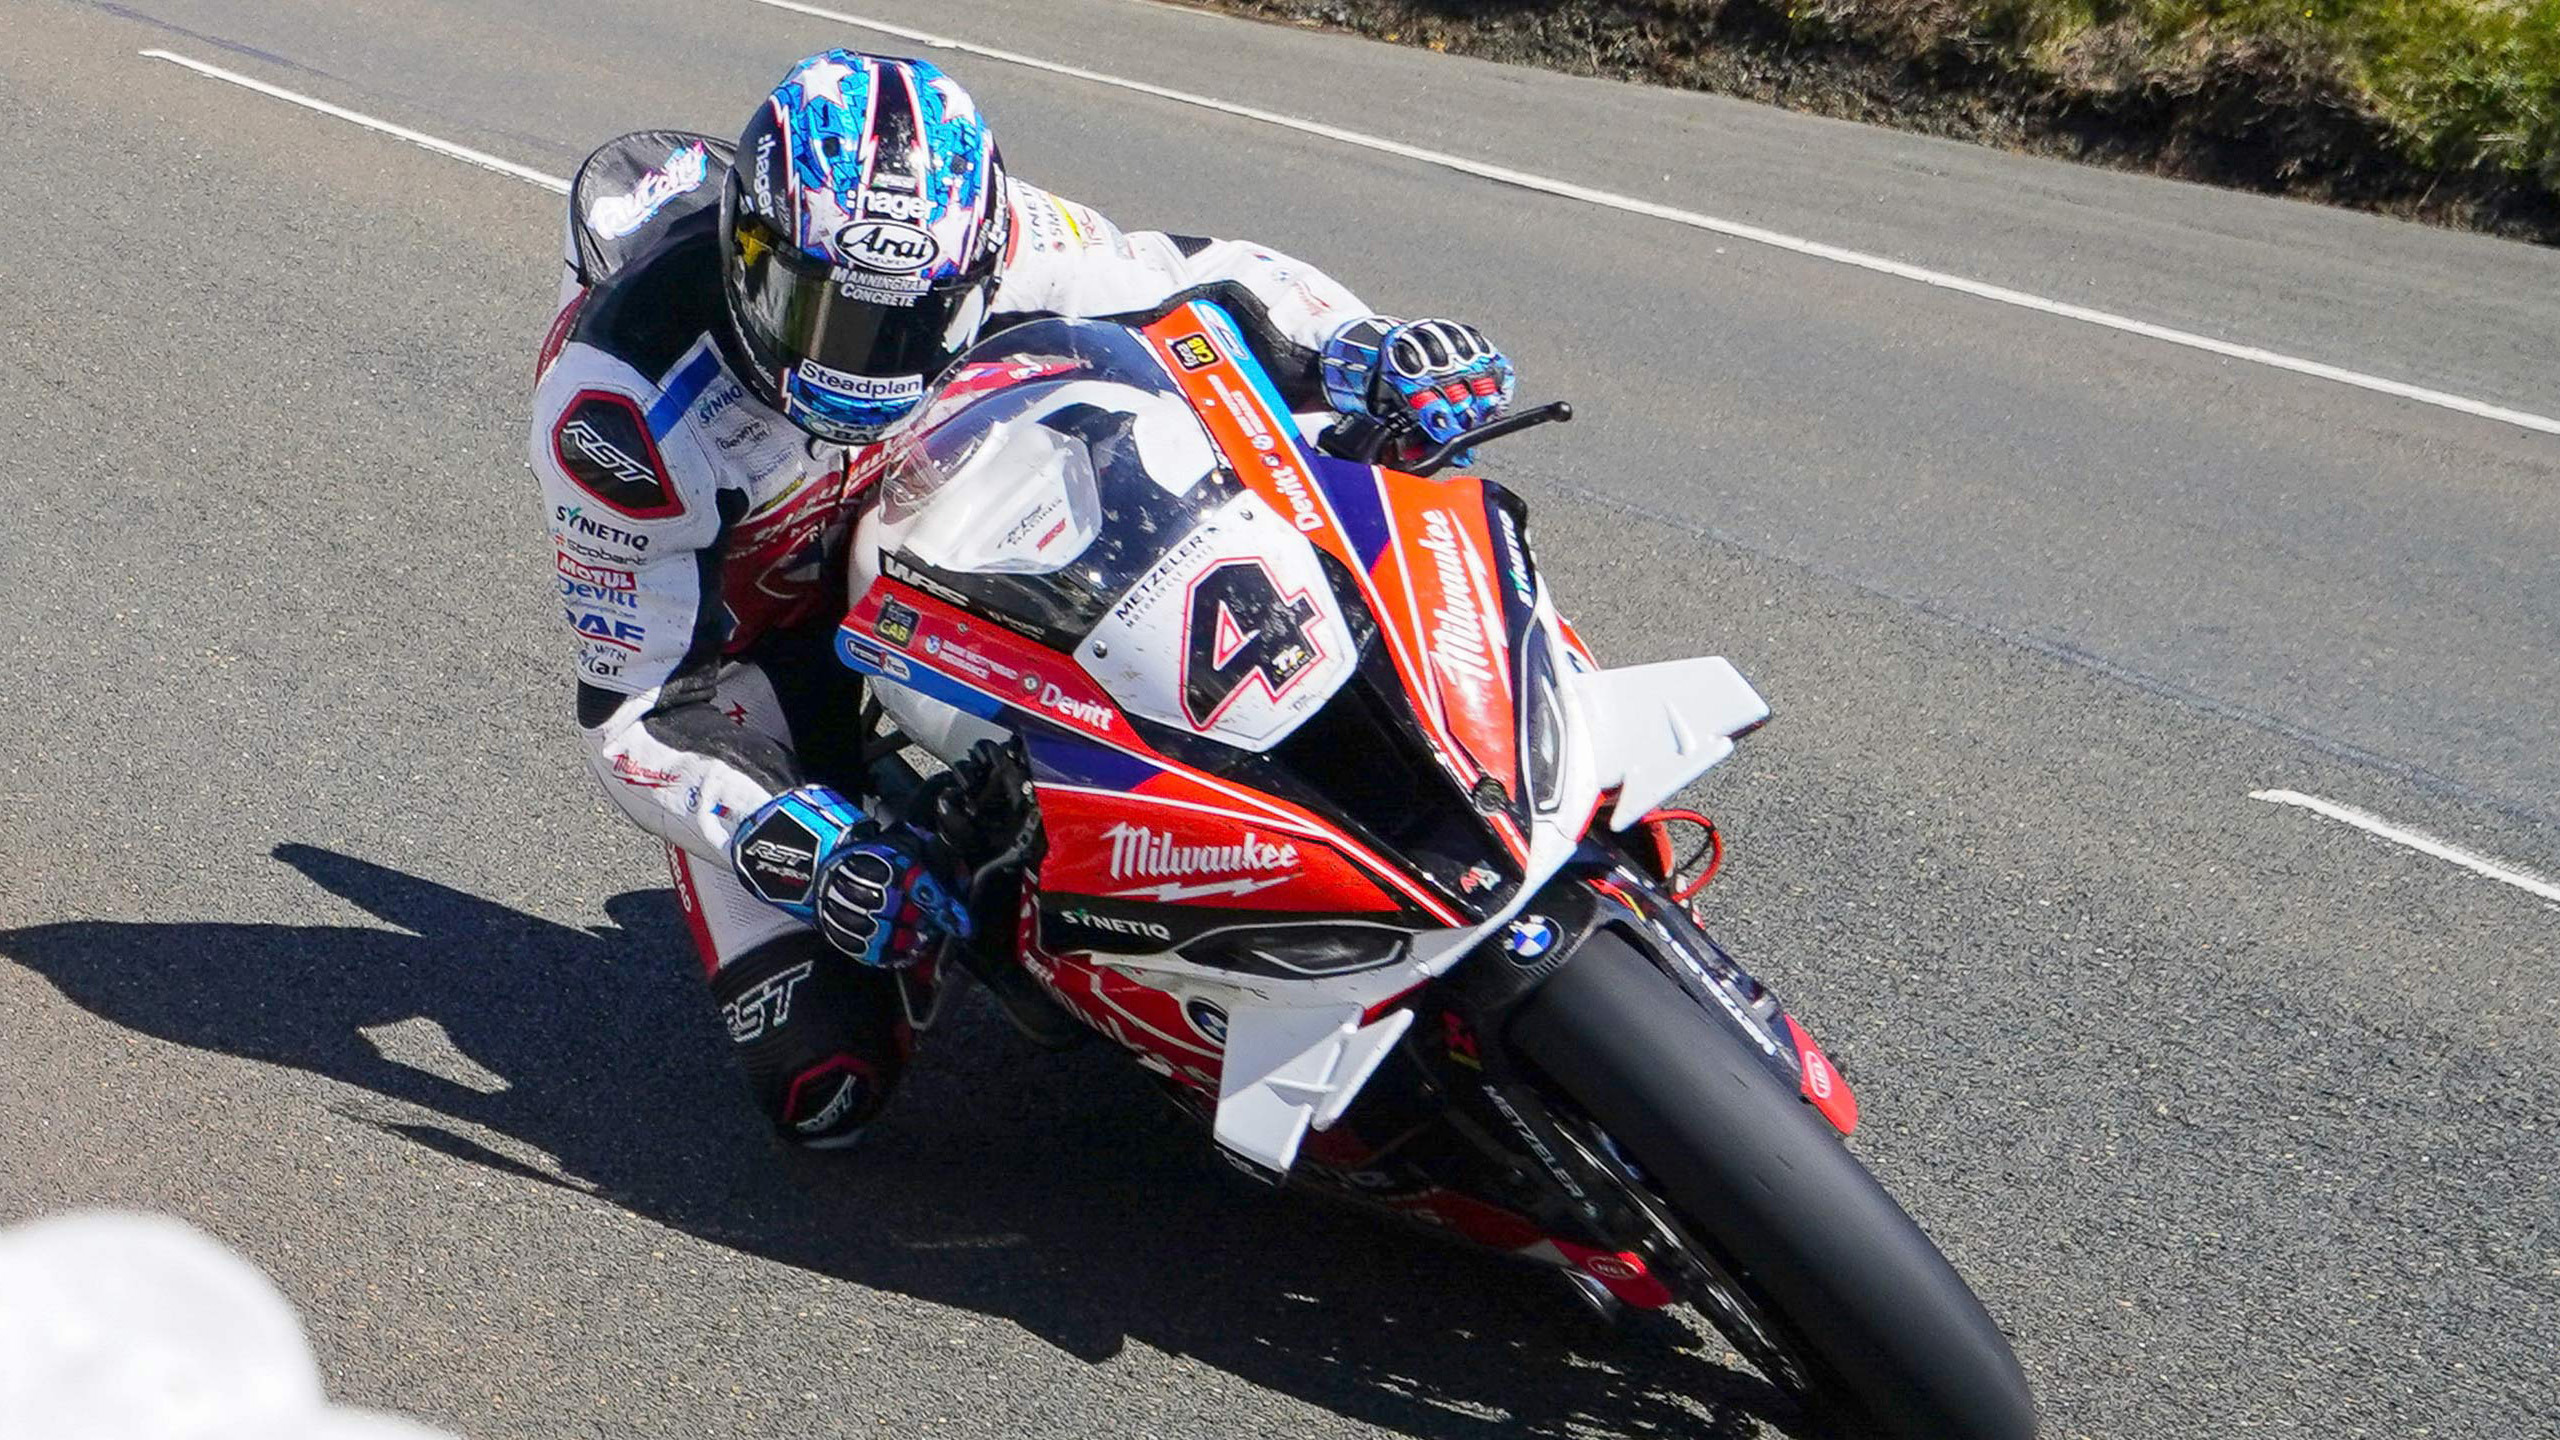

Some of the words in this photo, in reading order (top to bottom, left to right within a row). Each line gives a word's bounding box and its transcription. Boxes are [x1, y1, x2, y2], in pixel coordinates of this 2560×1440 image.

[841, 226, 928, 259] Arai
[830, 265, 932, 293] MANNINGHAM
[840, 282, 916, 307] CONCRETE
[1186, 337, 1215, 364] CAB
[802, 362, 919, 398] Steadplan
[562, 420, 660, 486] RST
[1272, 465, 1324, 532] Devitt
[556, 505, 650, 551] SYNETIQ
[560, 557, 633, 588] MOTUL
[1114, 534, 1205, 622] METZELER
[1419, 509, 1493, 686] Milwaukee
[879, 619, 910, 643] CAB
[1181, 556, 1326, 732] 4
[1039, 682, 1114, 732] Devitt
[746, 839, 813, 869] RST
[1100, 821, 1300, 880] Milwaukee
[1060, 908, 1171, 941] SYNETIQ
[1481, 1084, 1585, 1199] METZELER
